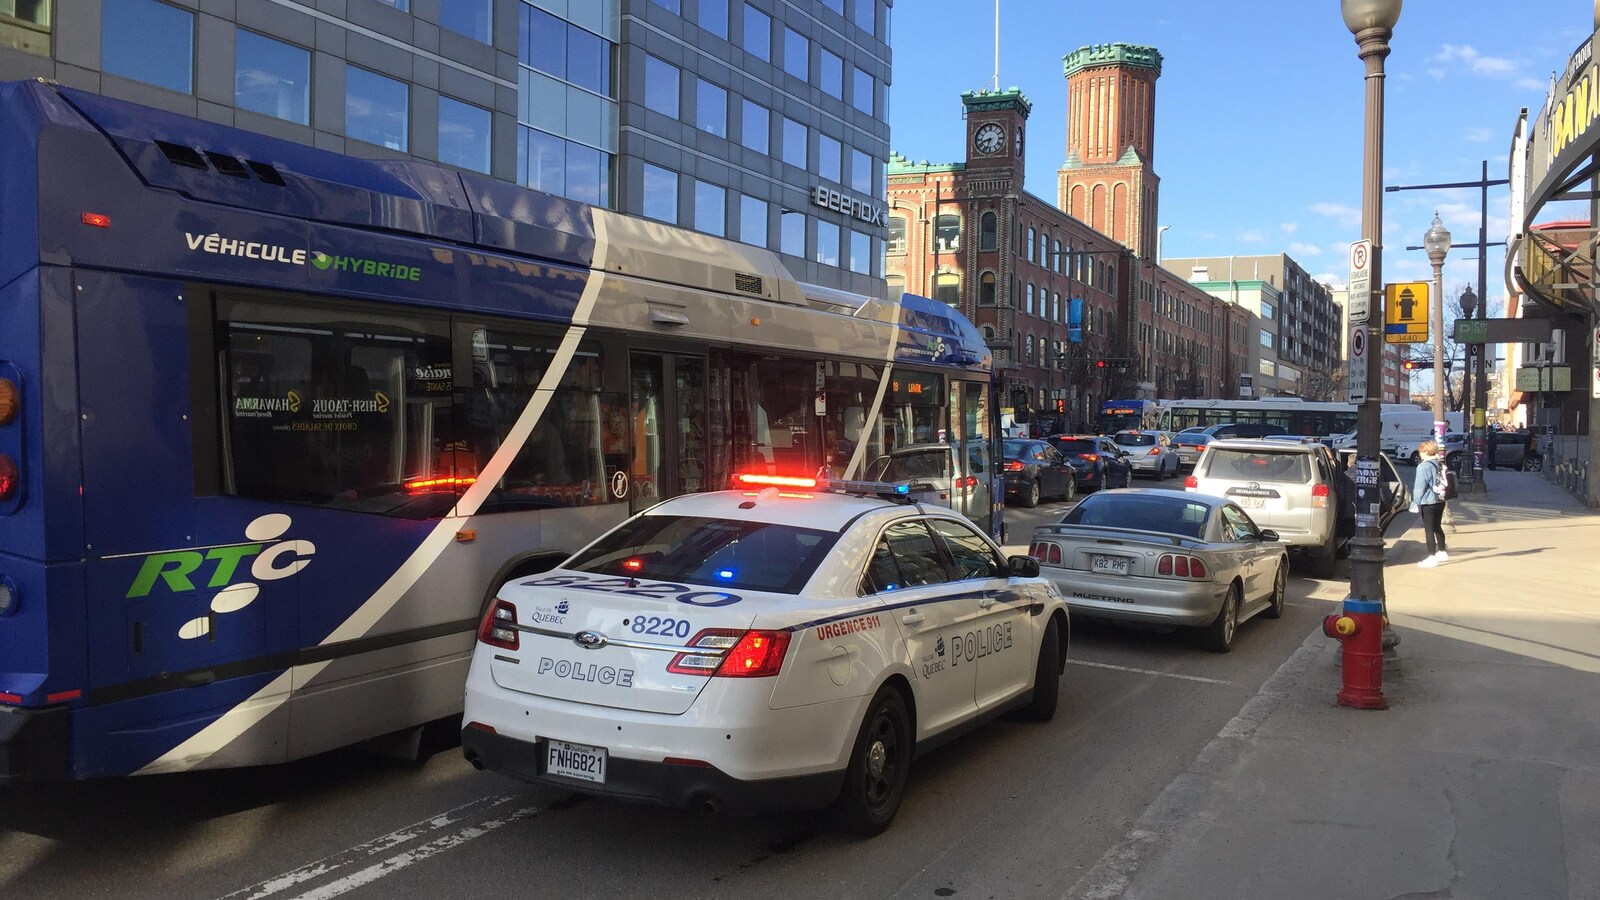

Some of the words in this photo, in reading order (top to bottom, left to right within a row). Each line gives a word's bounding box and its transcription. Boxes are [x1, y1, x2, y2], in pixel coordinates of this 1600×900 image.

[125, 539, 316, 599] RTC
[520, 576, 743, 608] 8220
[1072, 592, 1135, 604] MUSTANG
[631, 615, 691, 638] 8220
[816, 617, 867, 641] URGENCE
[866, 615, 881, 629] 911
[952, 621, 1013, 667] POLICE
[538, 657, 635, 687] POLICE
[550, 747, 603, 775] FNH6821
